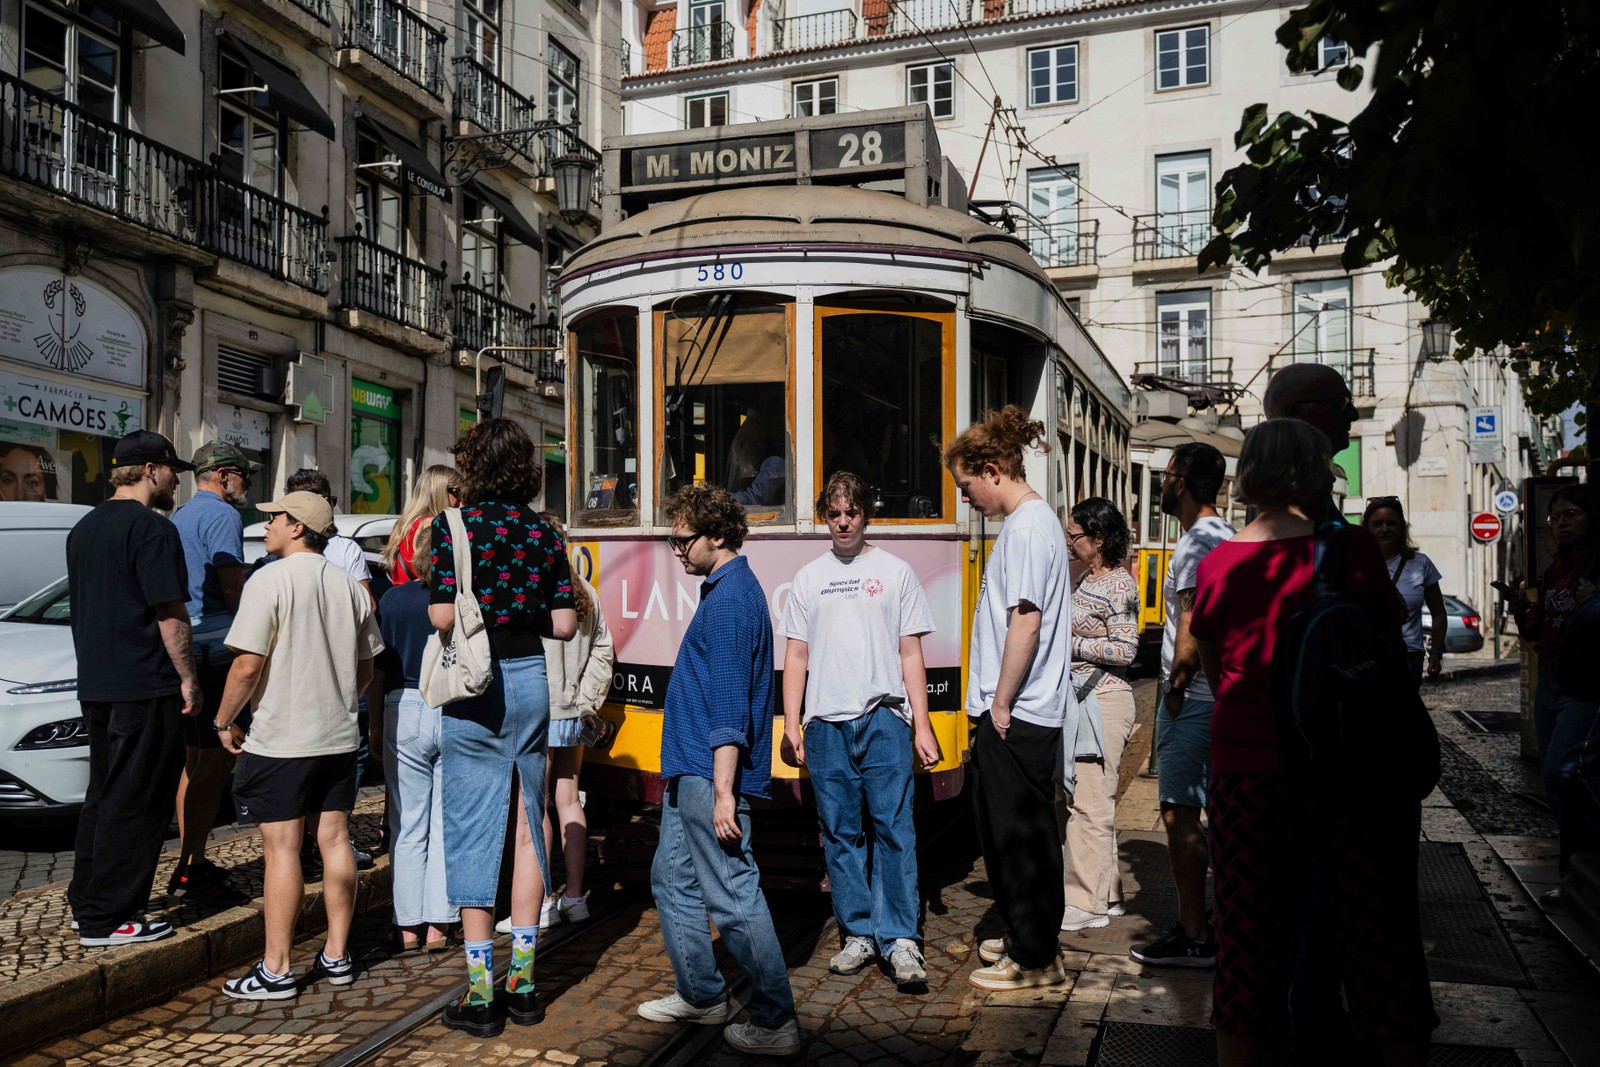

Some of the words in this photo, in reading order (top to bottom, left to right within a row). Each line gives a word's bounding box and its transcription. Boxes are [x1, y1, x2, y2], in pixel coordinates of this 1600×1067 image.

[646, 154, 680, 178] M.
[690, 144, 794, 176] MONIZ
[838, 130, 883, 168] 28
[407, 170, 415, 182] LE
[416, 176, 446, 197] CONSULAT
[697, 262, 743, 282] 580
[44, 385, 83, 399] FARMÁCIA
[18, 396, 106, 430] CAMÕES
